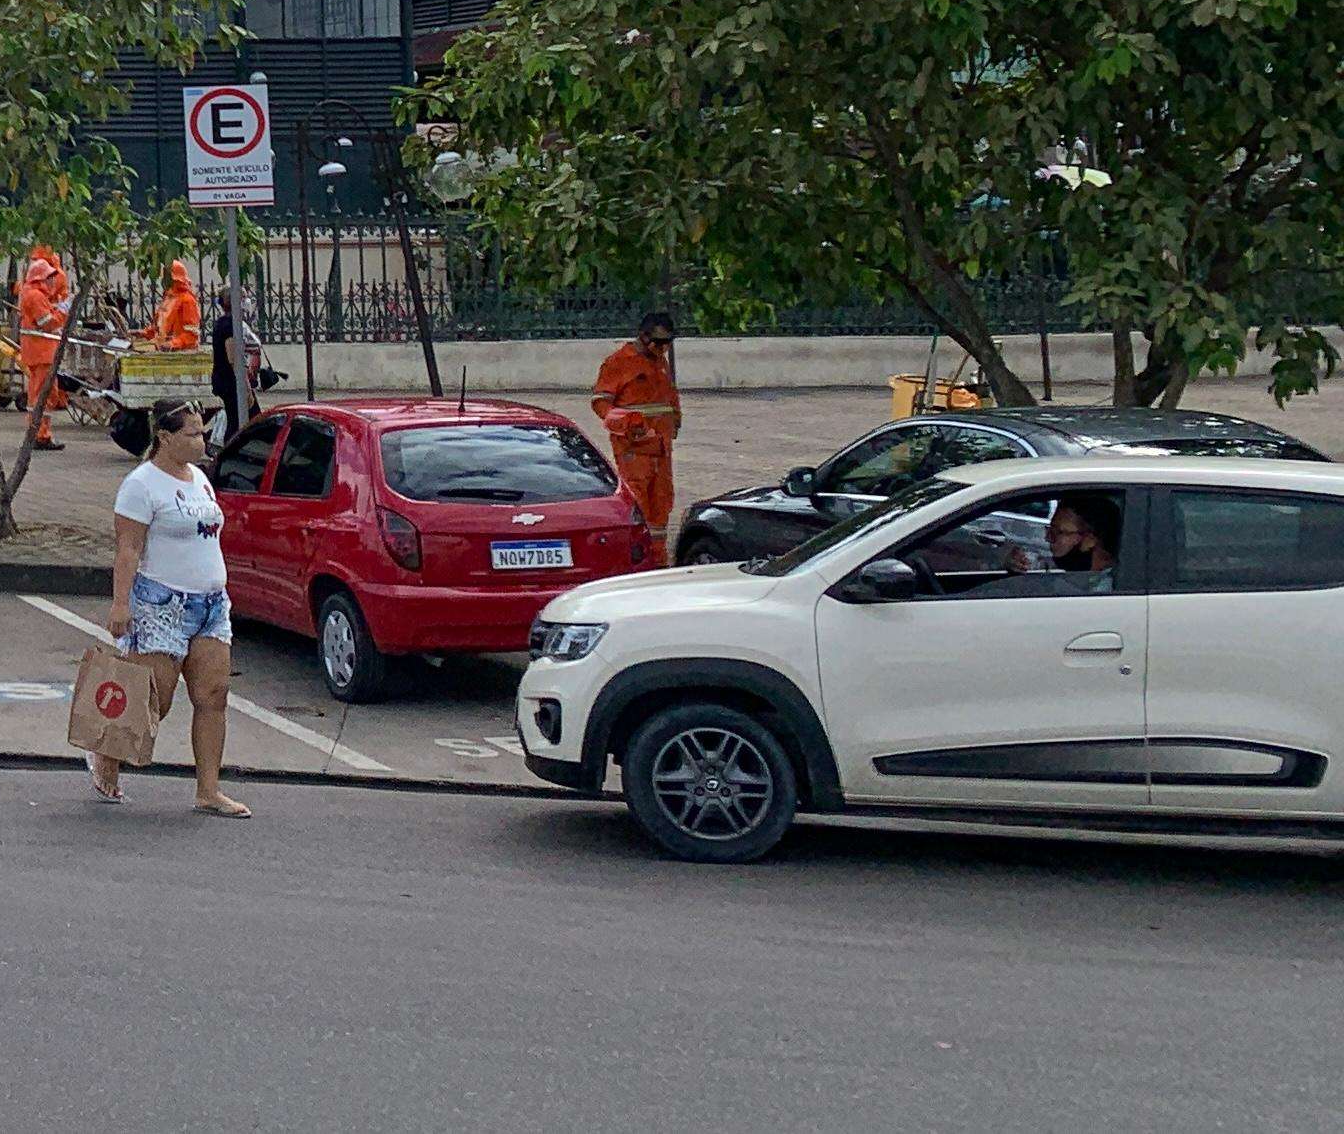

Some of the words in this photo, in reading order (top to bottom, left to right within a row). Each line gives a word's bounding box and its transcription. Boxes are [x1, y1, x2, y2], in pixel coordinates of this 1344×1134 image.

[211, 102, 245, 144] E
[192, 166, 231, 175] SOMENTE
[205, 175, 258, 184] AUTORIZADO
